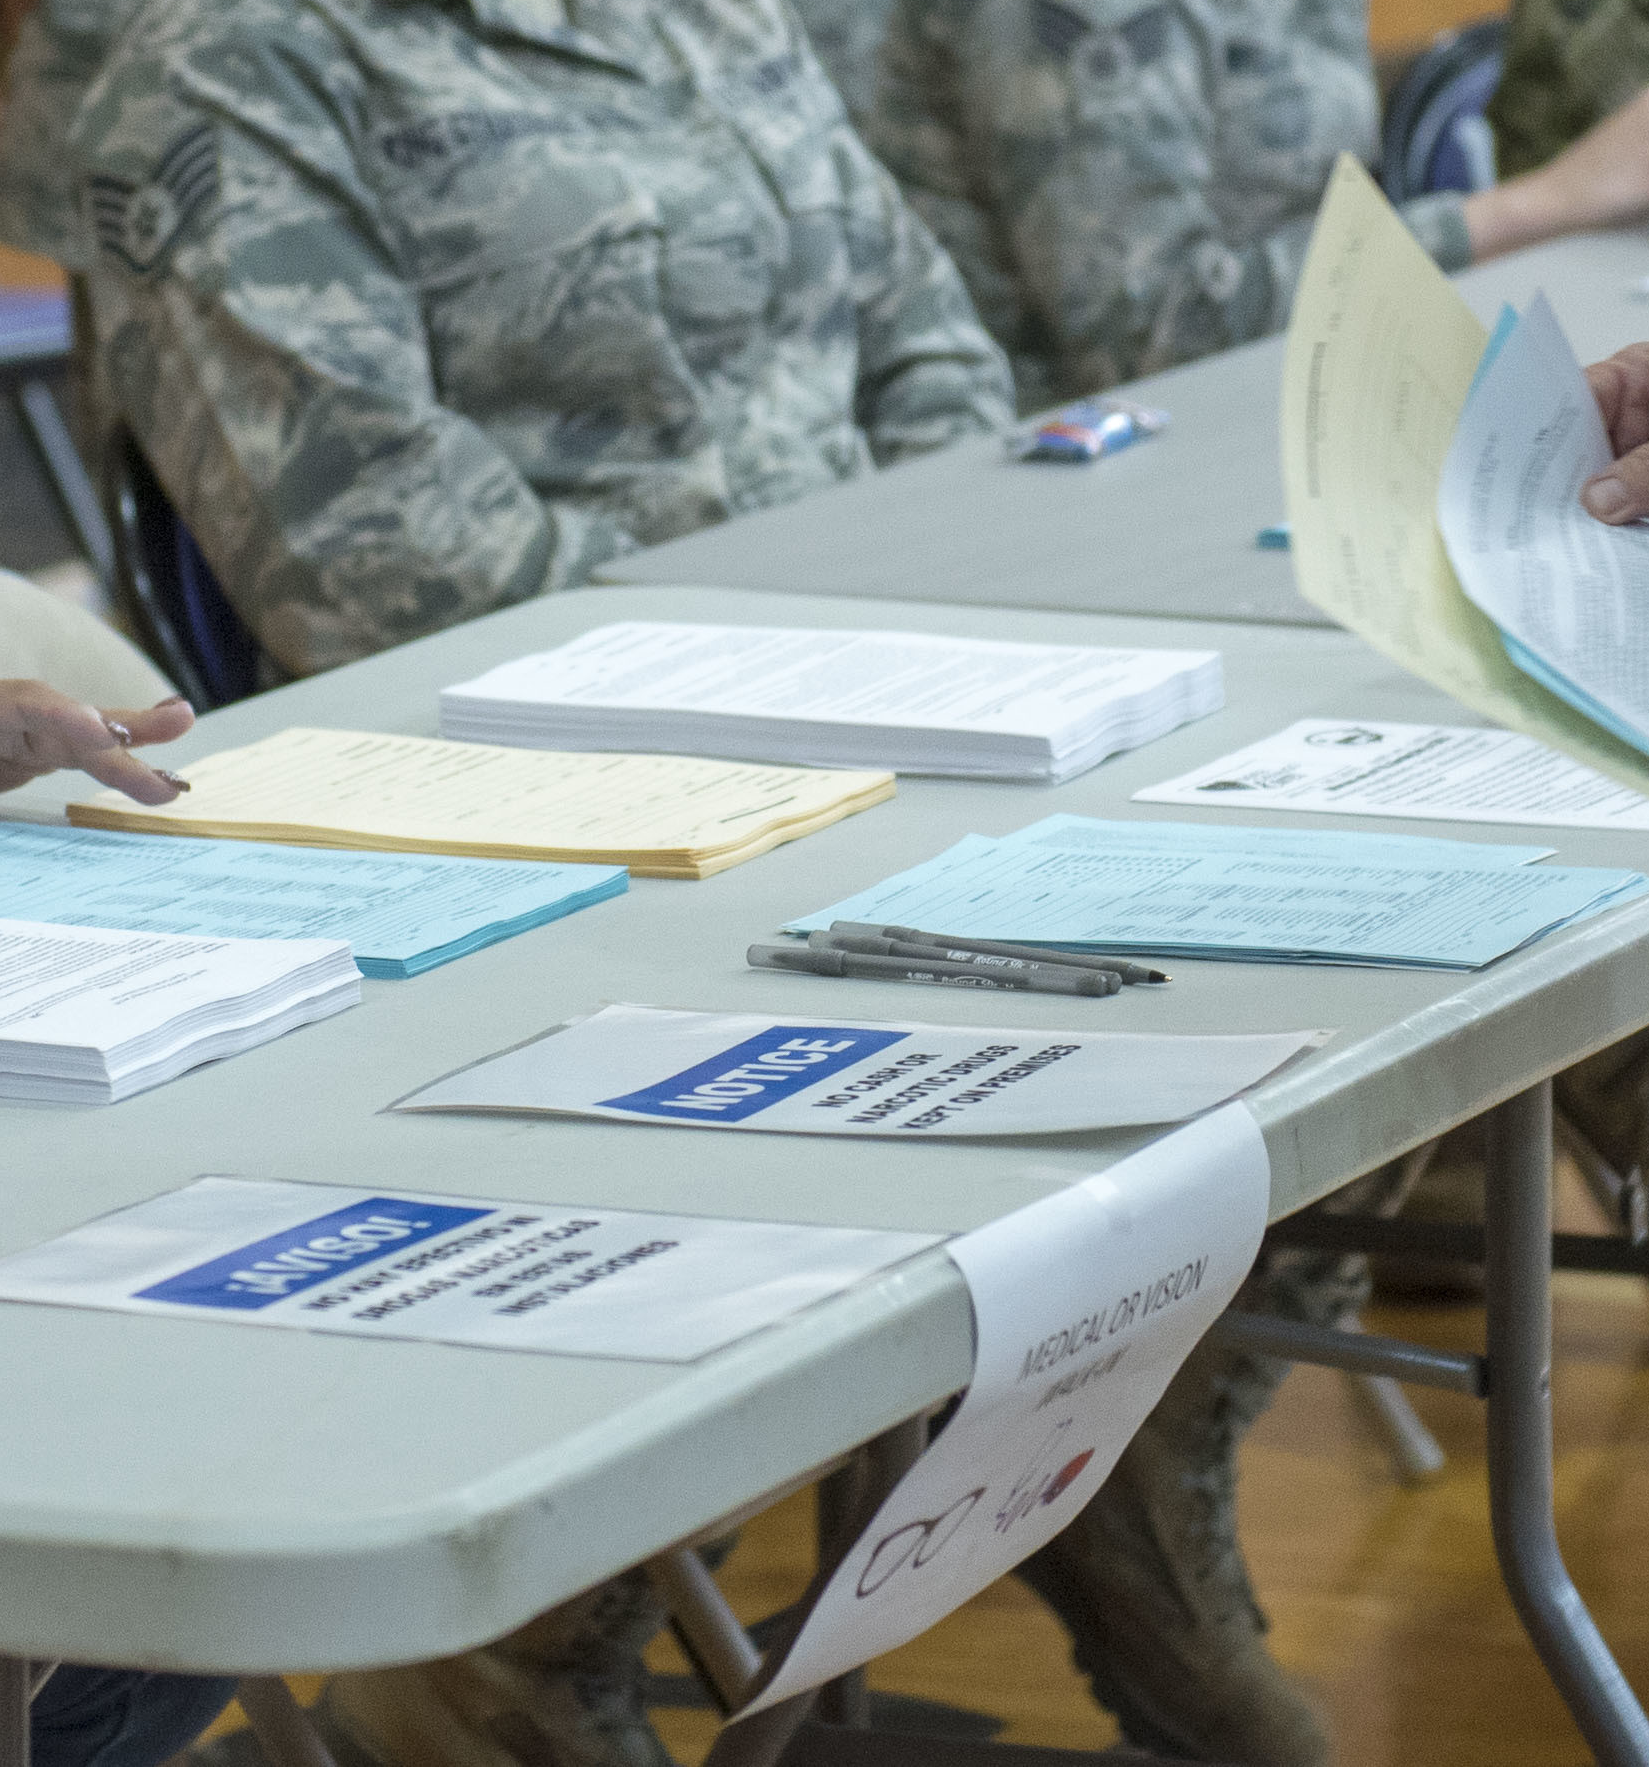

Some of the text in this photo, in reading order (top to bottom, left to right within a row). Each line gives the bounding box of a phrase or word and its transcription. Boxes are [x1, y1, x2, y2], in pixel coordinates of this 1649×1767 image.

[659, 1038, 857, 1112] NOTICE
[812, 1053, 944, 1108] NO CASH OR
[845, 1044, 1020, 1124] NARCOTIC DRUGS
[896, 1044, 1083, 1129] KEPT ON PREMISES
[224, 1215, 432, 1296] ¡AVISO!
[1015, 1254, 1209, 1385] MEDICAL OR VISION
